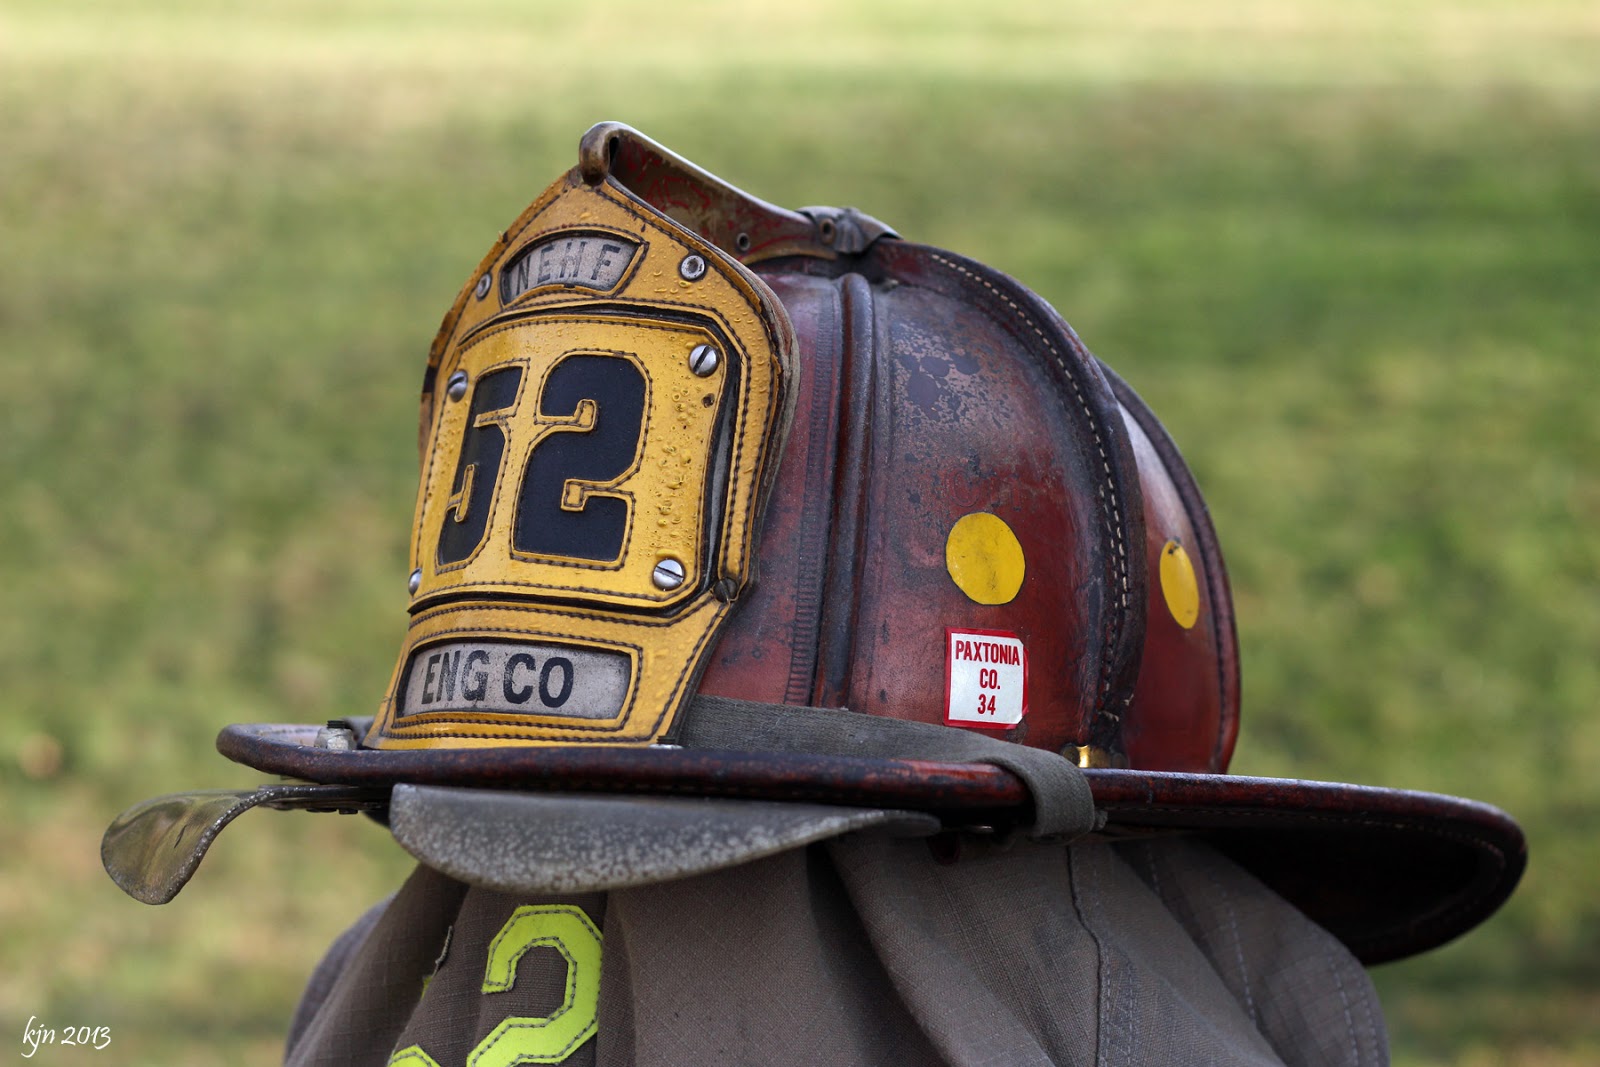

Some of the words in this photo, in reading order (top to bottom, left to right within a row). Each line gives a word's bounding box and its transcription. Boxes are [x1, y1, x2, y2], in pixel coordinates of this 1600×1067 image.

[436, 352, 648, 564] 52
[955, 640, 1020, 666] PAXTONIA
[421, 650, 491, 704] ENG
[503, 653, 574, 708] CO
[979, 668, 1001, 690] CO.
[977, 694, 996, 715] 34
